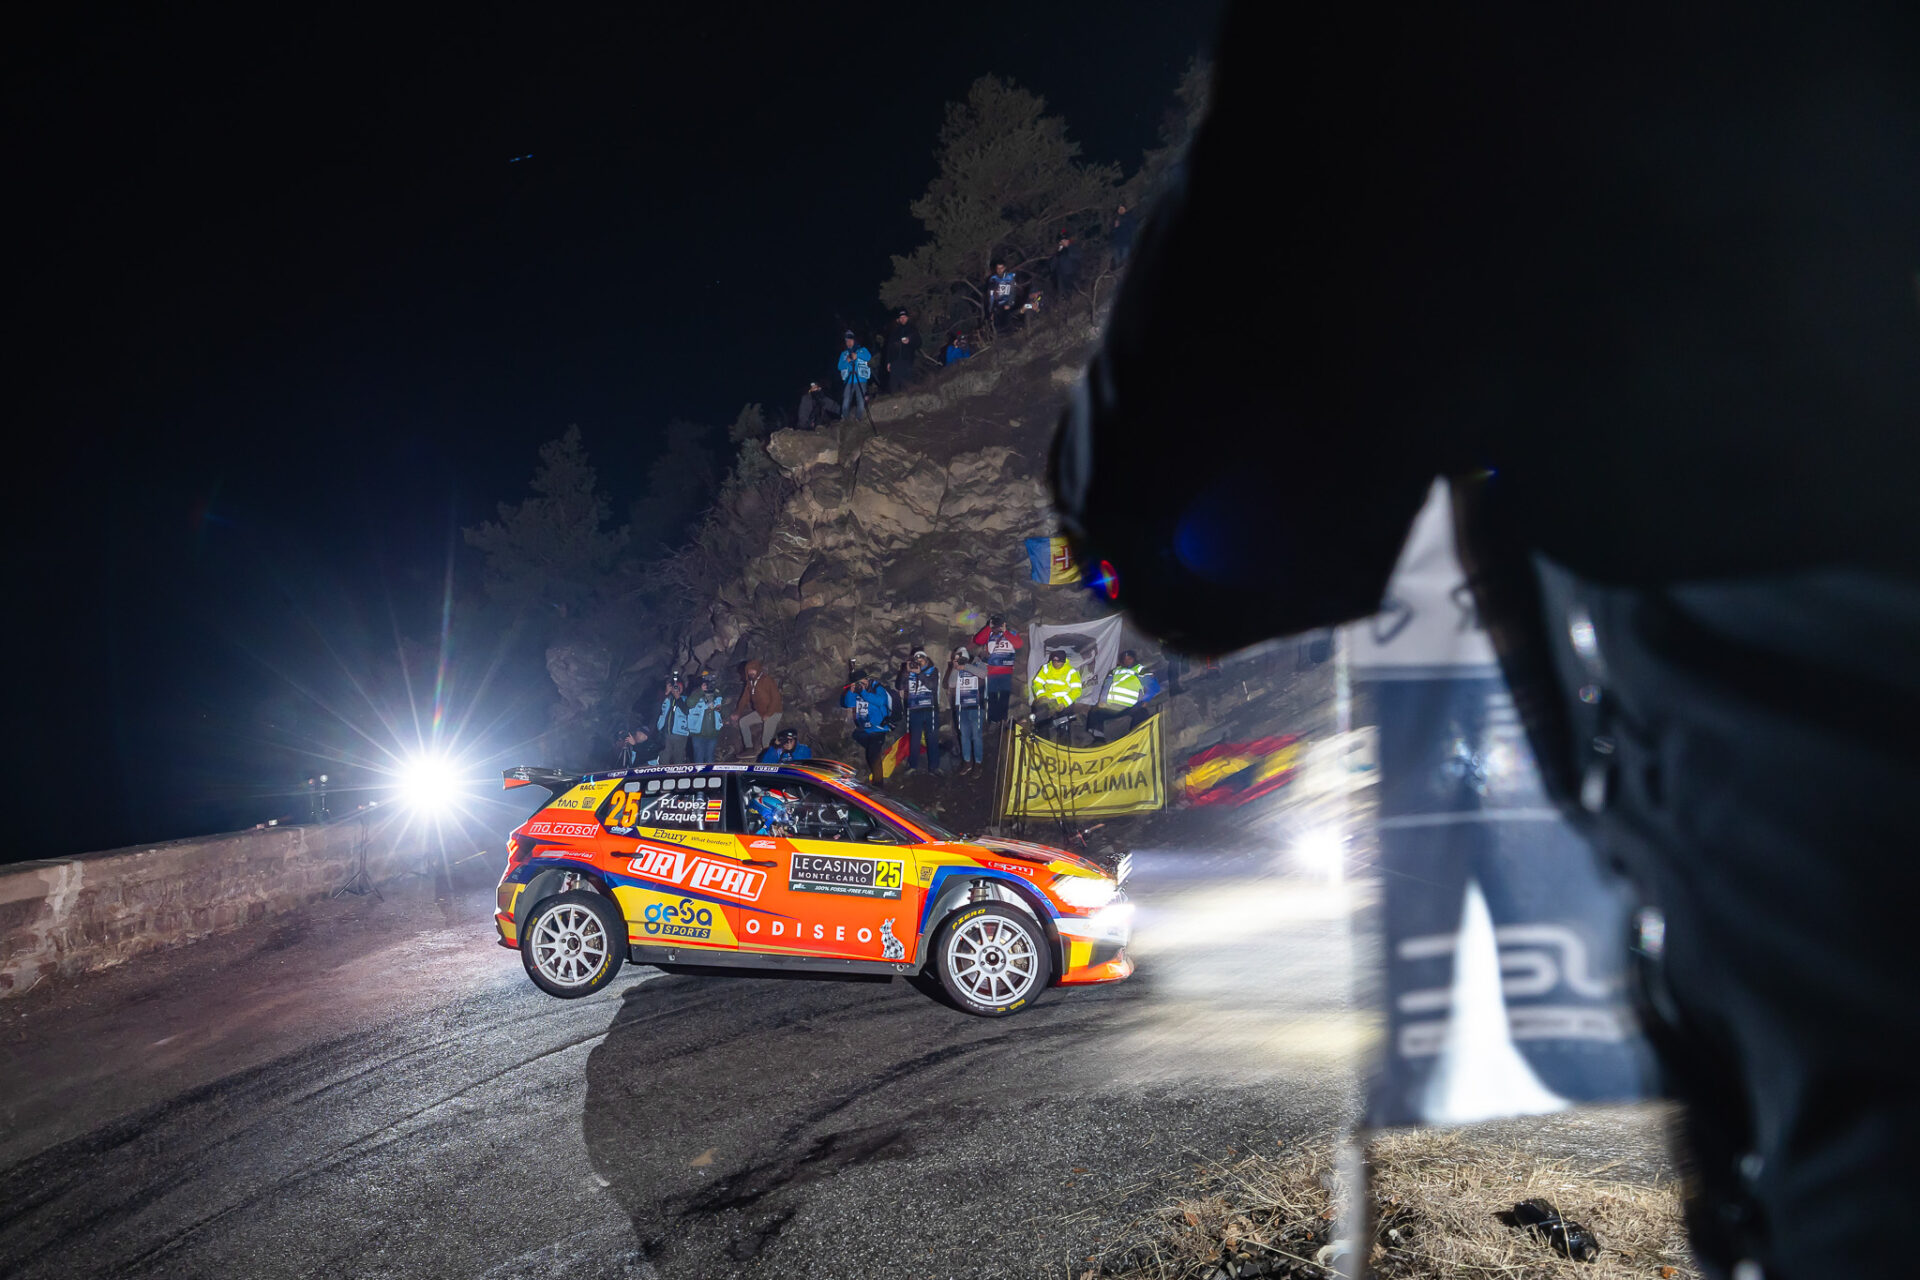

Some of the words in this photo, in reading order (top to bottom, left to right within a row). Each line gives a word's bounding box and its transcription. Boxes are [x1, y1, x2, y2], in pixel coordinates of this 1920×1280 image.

[1027, 781, 1058, 800] DO
[1062, 770, 1148, 799] WALIMIA
[604, 790, 642, 828] 25
[661, 798, 706, 811] P.Lopez
[655, 811, 704, 822] Vazquez
[653, 828, 687, 843] Ebury
[794, 857, 810, 870] LE
[812, 858, 873, 875] CASINO
[875, 861, 901, 888] 25
[664, 925, 709, 938] SPORTS
[746, 919, 872, 943] ODISEO
